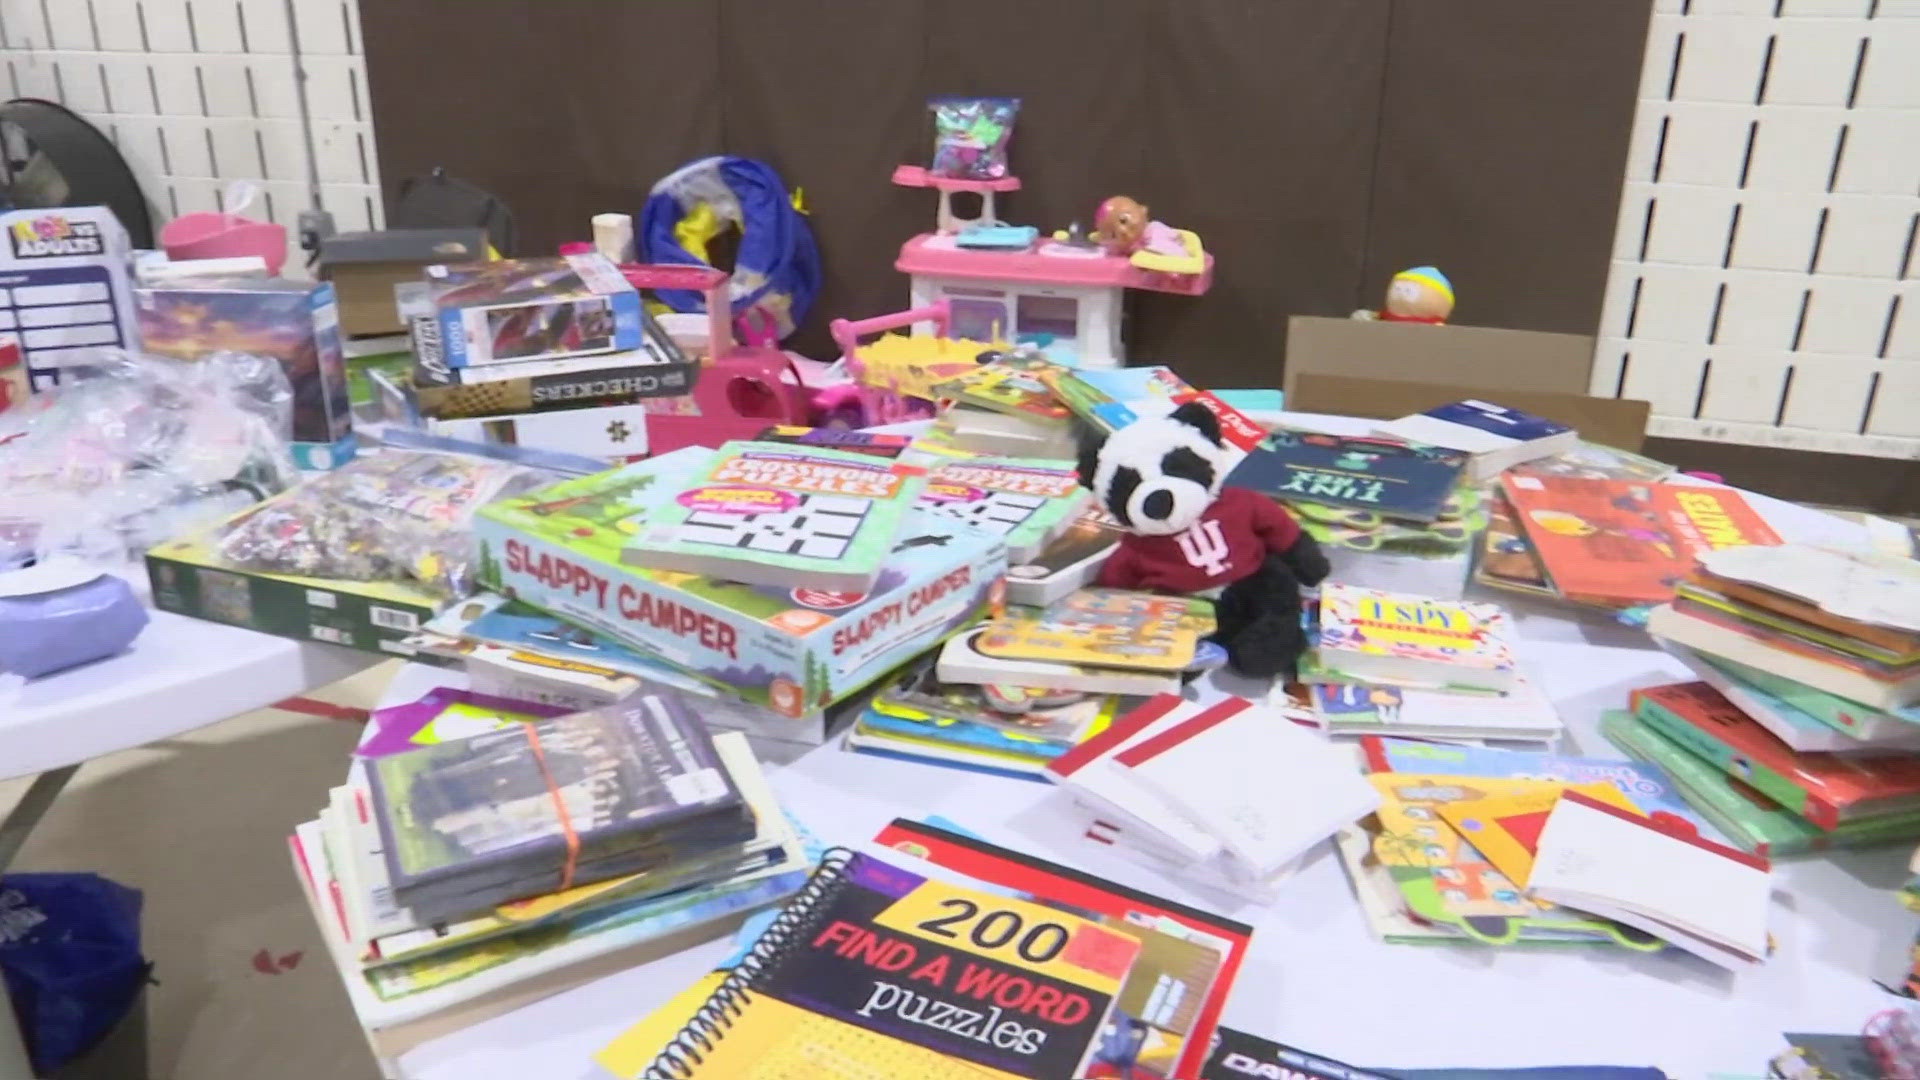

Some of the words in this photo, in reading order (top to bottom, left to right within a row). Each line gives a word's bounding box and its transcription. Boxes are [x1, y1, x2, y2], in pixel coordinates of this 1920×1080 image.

[533, 376, 659, 402] CHECKERS
[717, 469, 890, 496] PUZZLES
[726, 458, 899, 485] CROSSWORD
[505, 538, 609, 609] SLAPPY
[618, 583, 737, 660] CAMPER
[832, 601, 902, 656] SLAPPY
[906, 564, 971, 617] CAMPER
[918, 897, 1070, 964] 200
[813, 920, 906, 976] FIND
[906, 954, 948, 988] A
[953, 963, 1091, 1028] WORD
[857, 980, 1048, 1056] puzzles
